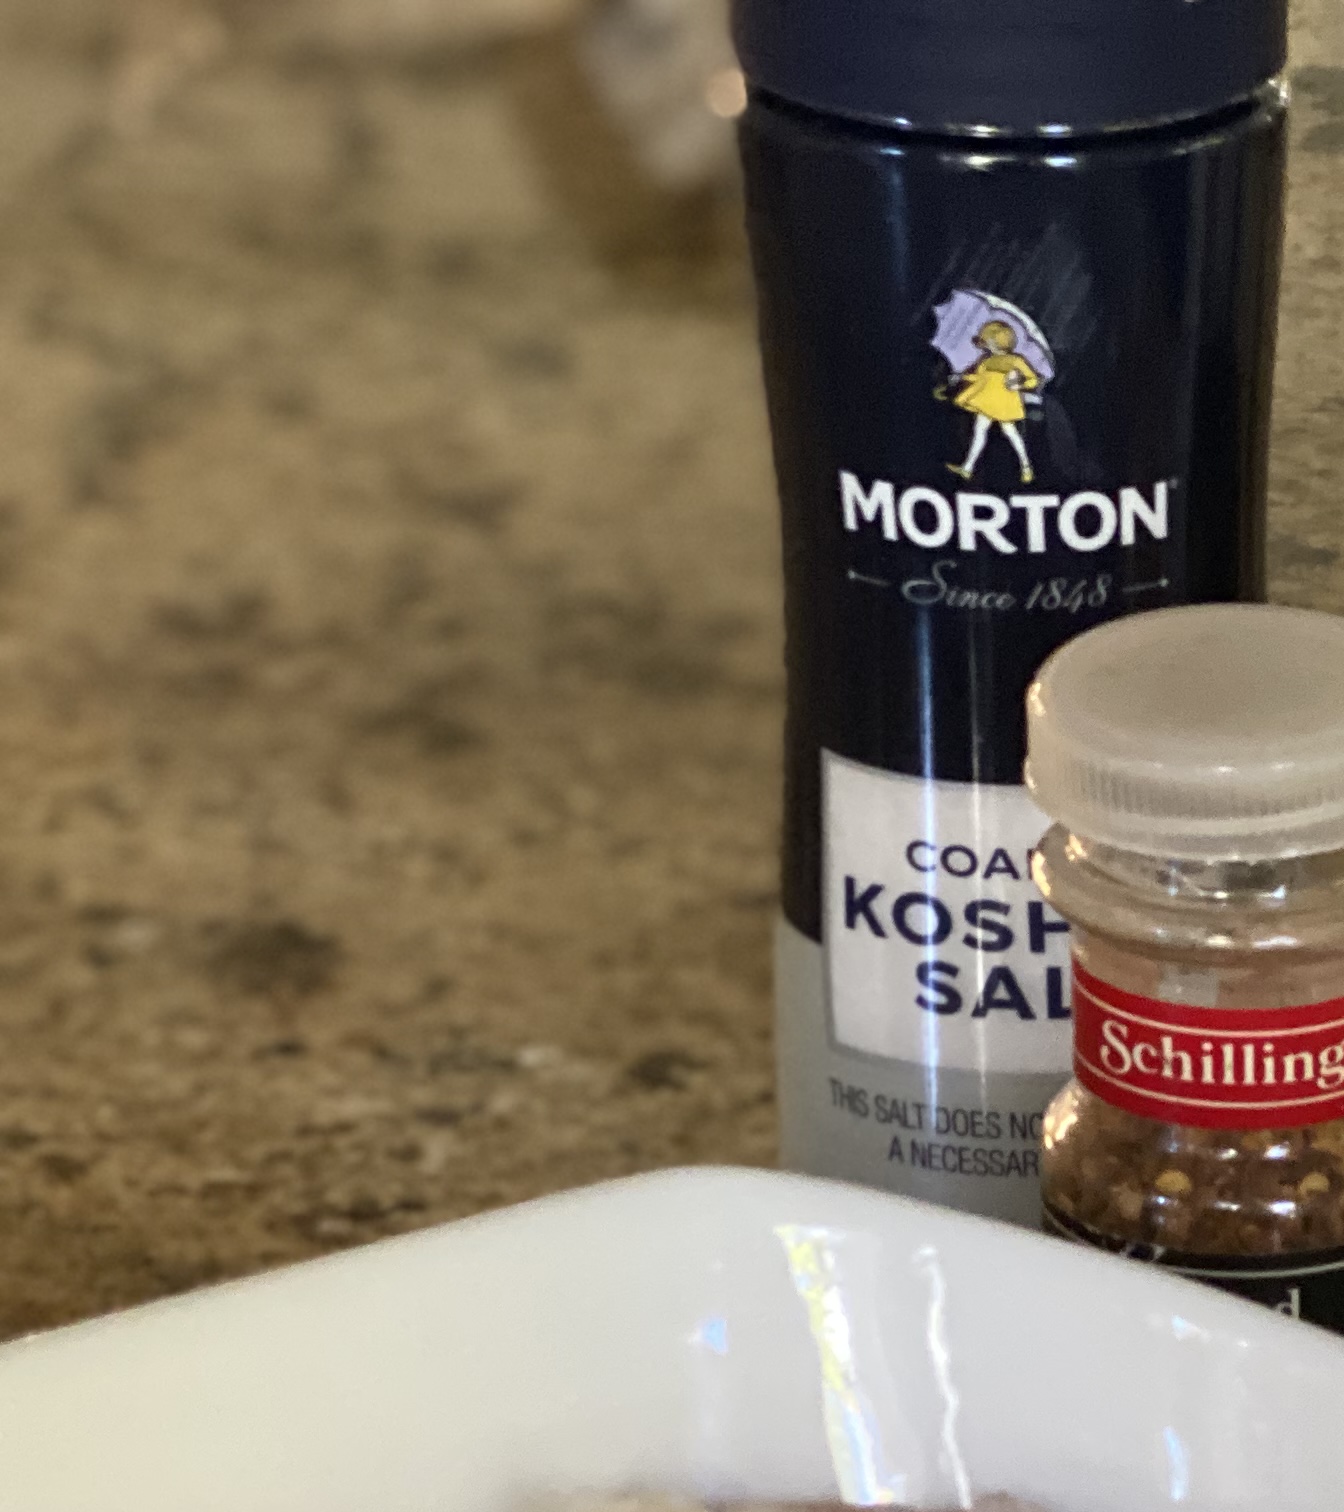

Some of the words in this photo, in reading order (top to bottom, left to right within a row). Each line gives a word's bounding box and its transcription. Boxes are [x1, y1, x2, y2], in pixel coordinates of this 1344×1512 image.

[838, 469, 1168, 554] MORTON
[902, 559, 1016, 610] Since
[1025, 573, 1113, 613] 1848
[906, 840, 1036, 880] COA
[844, 875, 1071, 953] KOSH
[915, 960, 1072, 1021] SAL
[829, 1077, 870, 1118] THIS
[874, 1094, 925, 1131] SALT
[935, 1106, 1002, 1140] DOES
[1010, 1112, 1043, 1141] NO
[888, 1135, 904, 1165] A
[910, 1138, 1040, 1177] NECESSAR
